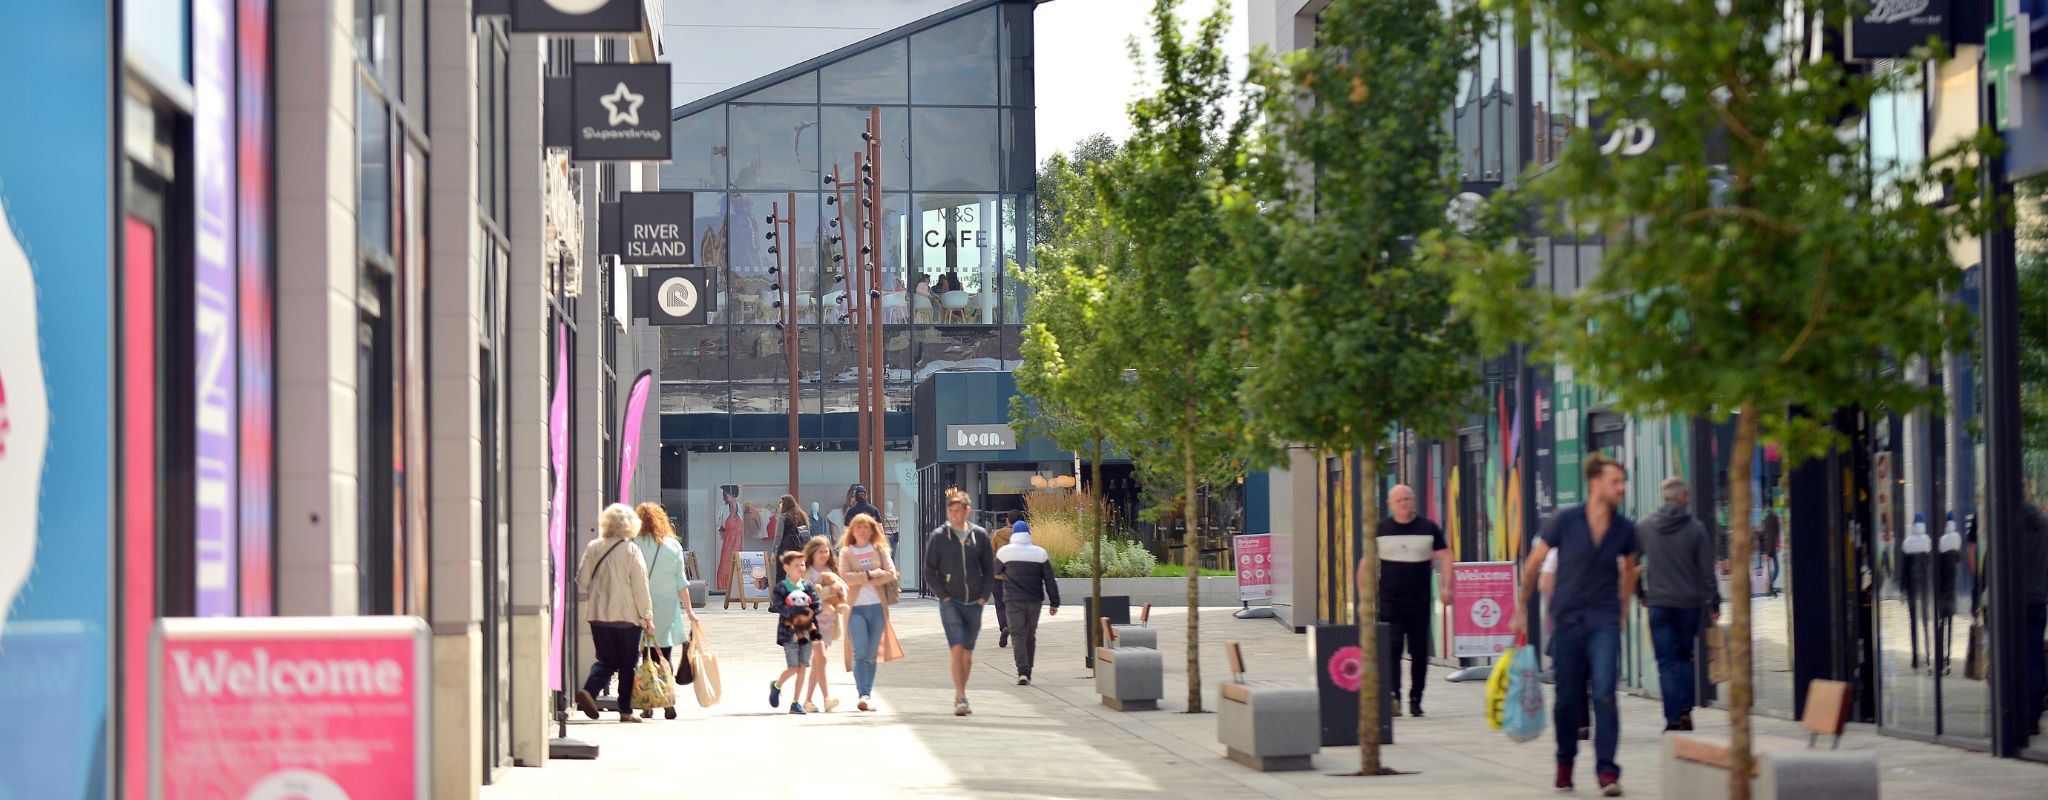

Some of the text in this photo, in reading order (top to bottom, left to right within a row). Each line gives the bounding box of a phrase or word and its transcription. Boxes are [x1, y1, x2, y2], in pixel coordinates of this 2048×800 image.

[582, 126, 662, 141] Superdrug
[1600, 118, 1656, 155] JD
[937, 207, 974, 223] M&S
[633, 224, 679, 239] RIVER
[924, 229, 988, 248] CAFE
[627, 241, 687, 257] ISLAND
[957, 429, 1006, 447] bean.
[1454, 569, 1512, 582] Welcome
[1480, 604, 1491, 619] 2
[171, 646, 404, 697] Welcome
